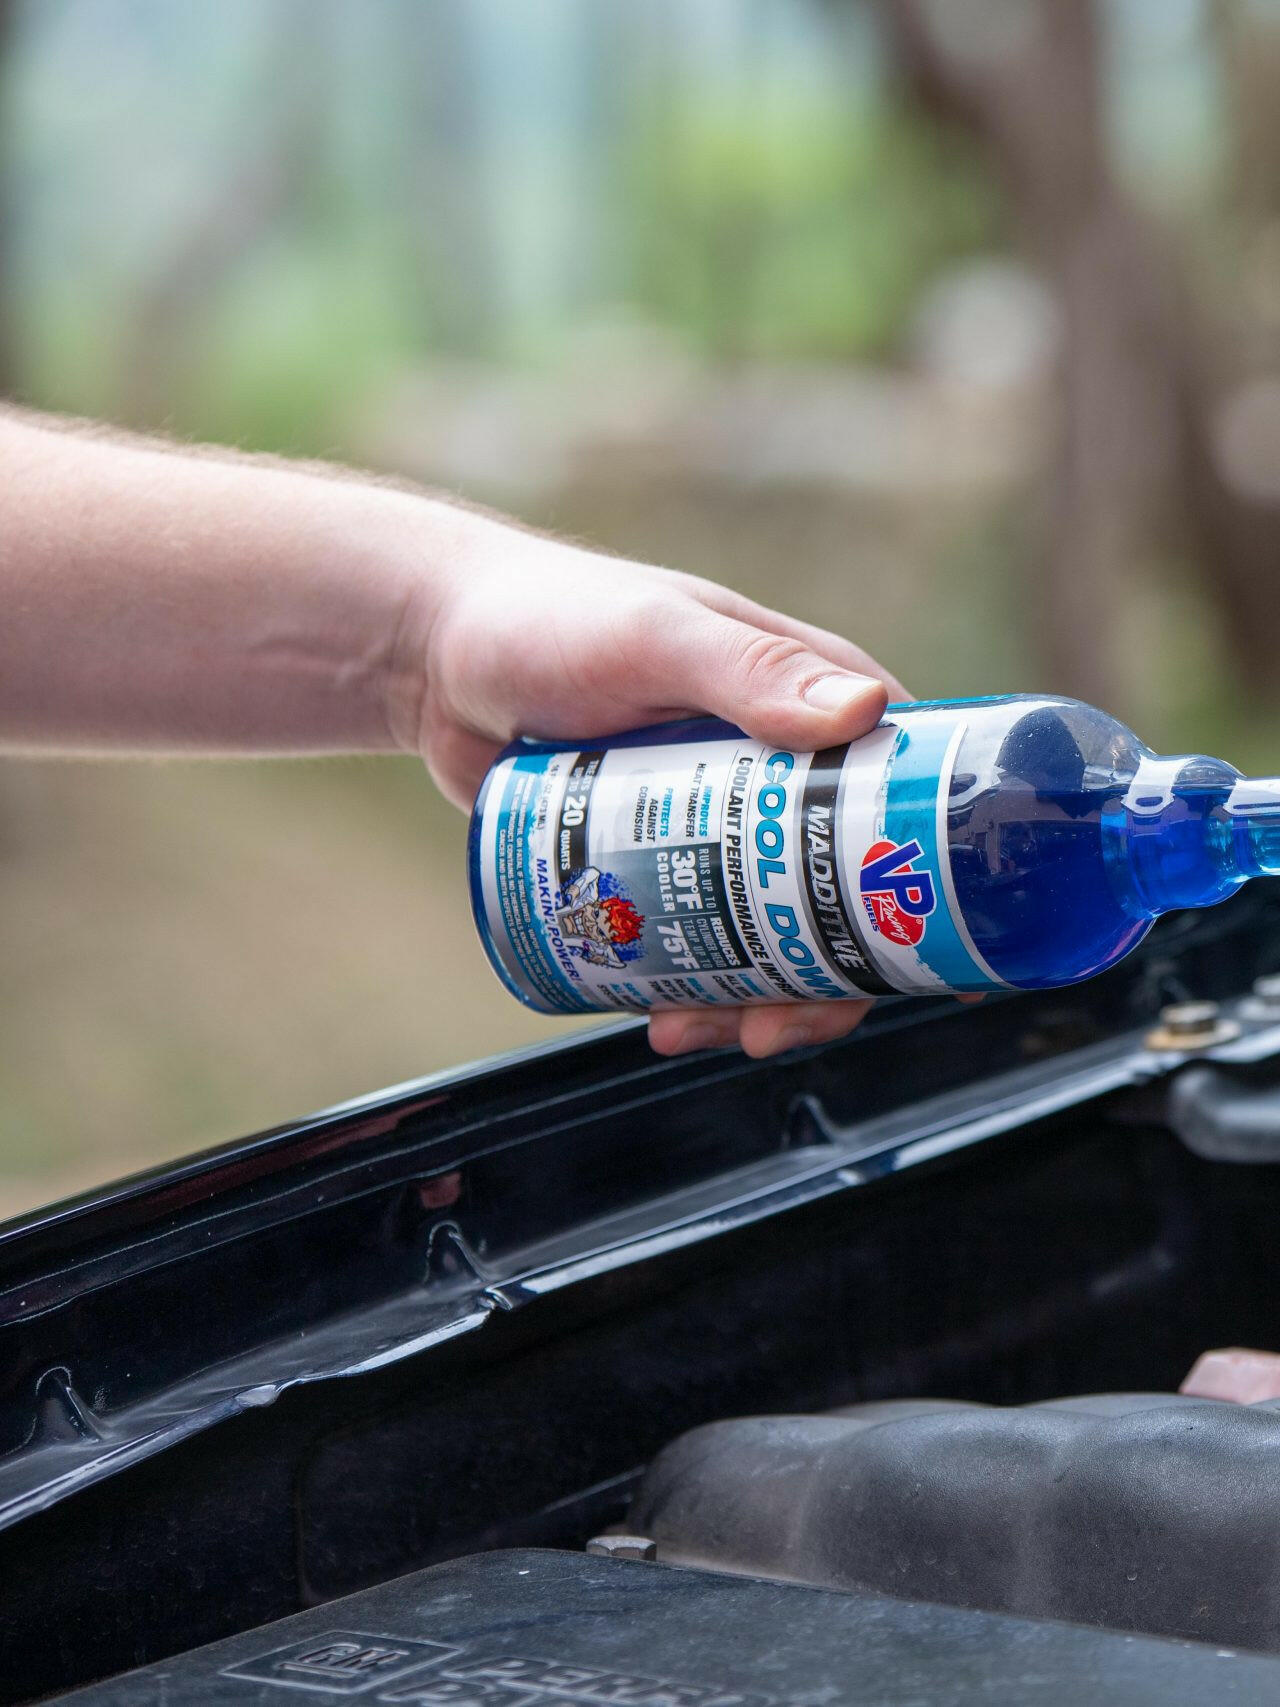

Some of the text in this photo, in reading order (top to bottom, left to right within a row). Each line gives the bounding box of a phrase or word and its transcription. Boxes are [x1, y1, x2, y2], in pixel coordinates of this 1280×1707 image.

[560, 760, 599, 870] TREATS UP TO 20 QUARTS
[633, 786, 649, 842] CORROSION
[660, 787, 674, 837] PROTECTS
[686, 763, 707, 838] HEAT TRANSFER
[698, 786, 712, 837] IMPROVES
[726, 756, 754, 830] COOLANT
[498, 829, 507, 857] CANCER
[646, 798, 658, 842] AGAINST
[499, 875, 508, 896] BIRTH
[508, 880, 516, 890] NO
[656, 852, 676, 912] COOLER
[671, 850, 703, 909] 30°F
[698, 848, 716, 909] RUNS UP TO
[726, 834, 768, 960] PERFORMANCE
[755, 752, 848, 998] COOL DOWN
[808, 804, 865, 968] MADDITIVE
[860, 838, 936, 916] VP
[502, 898, 514, 928] DEFECTS
[509, 892, 522, 930] CHEMICALS
[518, 879, 531, 922] SWALLOWED
[536, 859, 555, 922] MAKIN'
[547, 927, 583, 981] POWER!
[863, 896, 880, 932] FUELS
[871, 896, 914, 944] Racing
[656, 920, 700, 970] 75°F
[683, 920, 712, 968] TEMP UP TO
[696, 918, 727, 968] CYLINDER HEAD
[710, 917, 741, 966] REDUCES
[296, 1642, 412, 1675] GM
